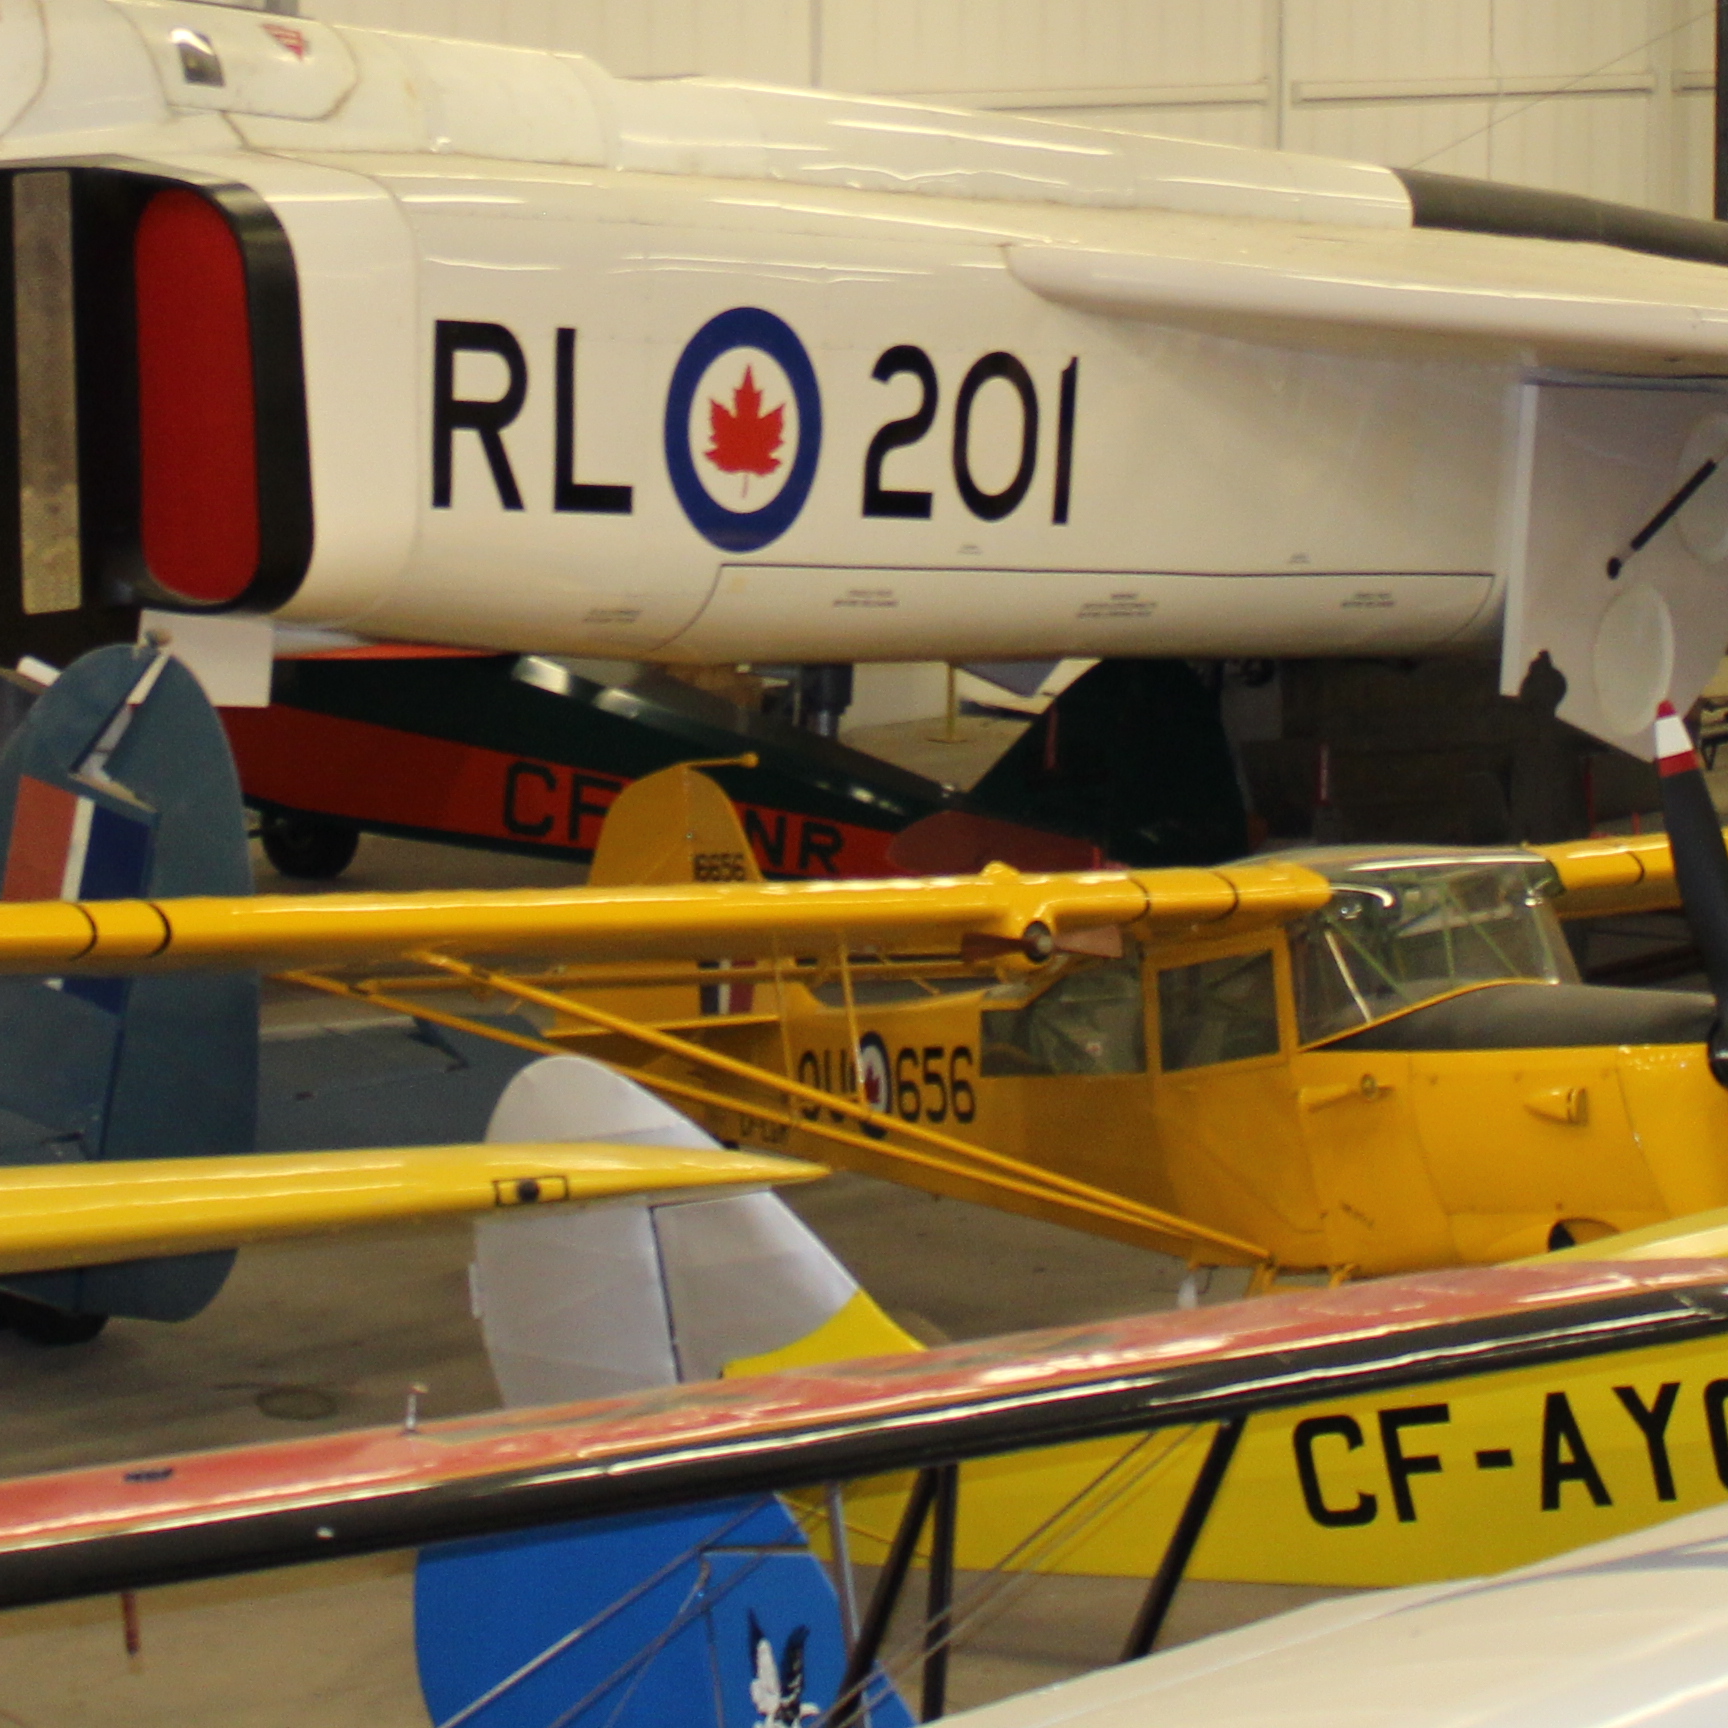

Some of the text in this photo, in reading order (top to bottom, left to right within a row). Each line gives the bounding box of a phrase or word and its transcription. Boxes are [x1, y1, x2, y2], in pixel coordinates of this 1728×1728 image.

[431, 319, 1078, 525] RL 201
[896, 1046, 976, 1123] 656
